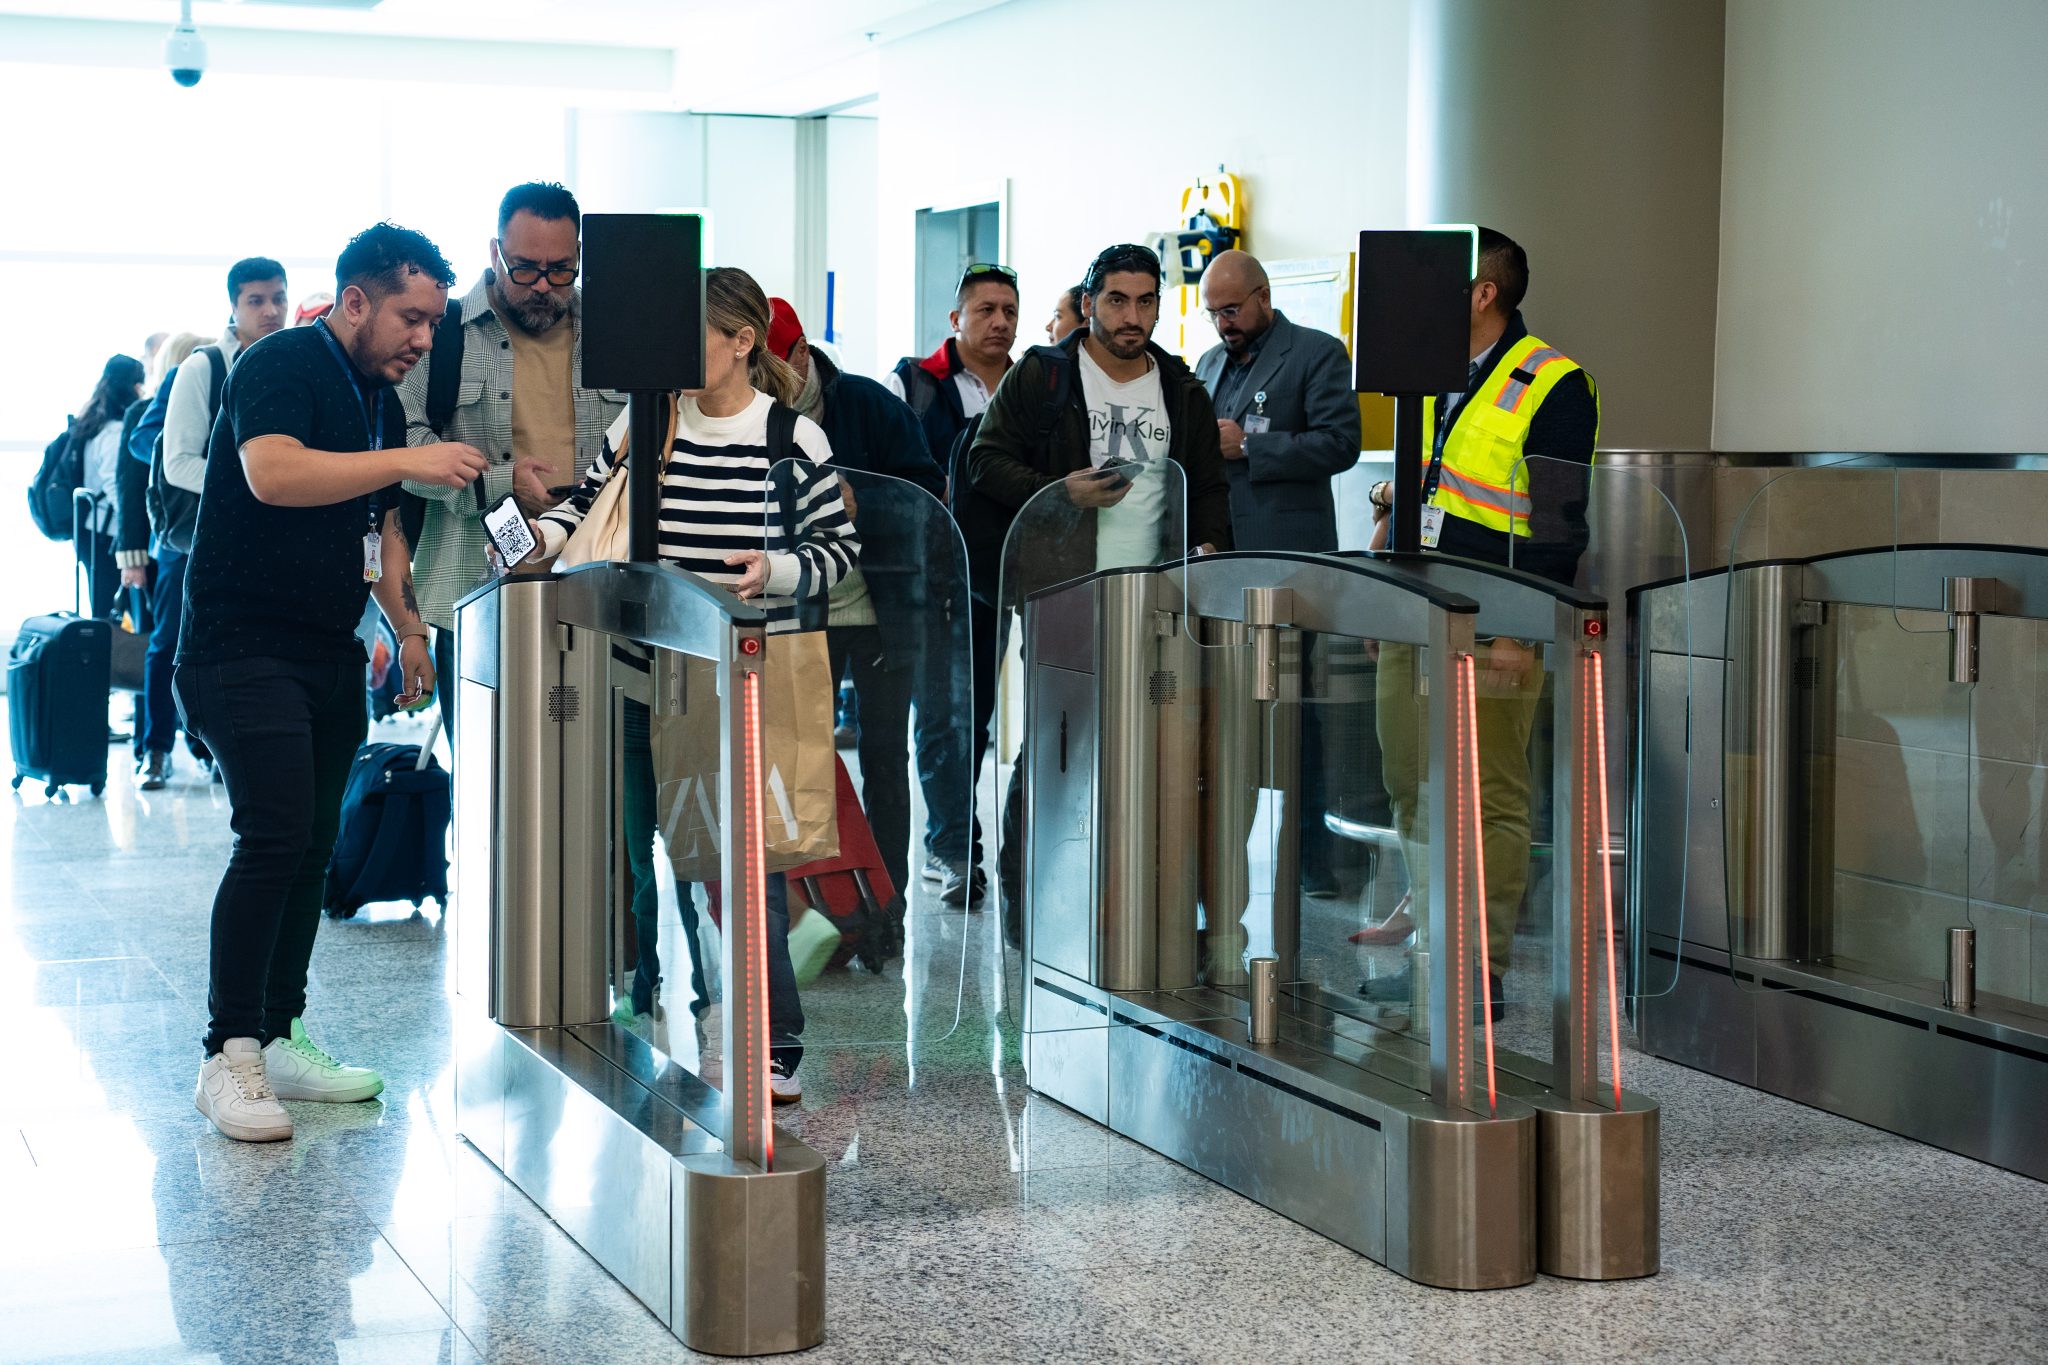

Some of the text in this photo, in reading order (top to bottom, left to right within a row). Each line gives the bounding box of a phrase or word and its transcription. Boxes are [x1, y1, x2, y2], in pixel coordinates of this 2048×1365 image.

[1092, 415, 1169, 443] lvin Klei
[657, 763, 798, 861] ZAA
